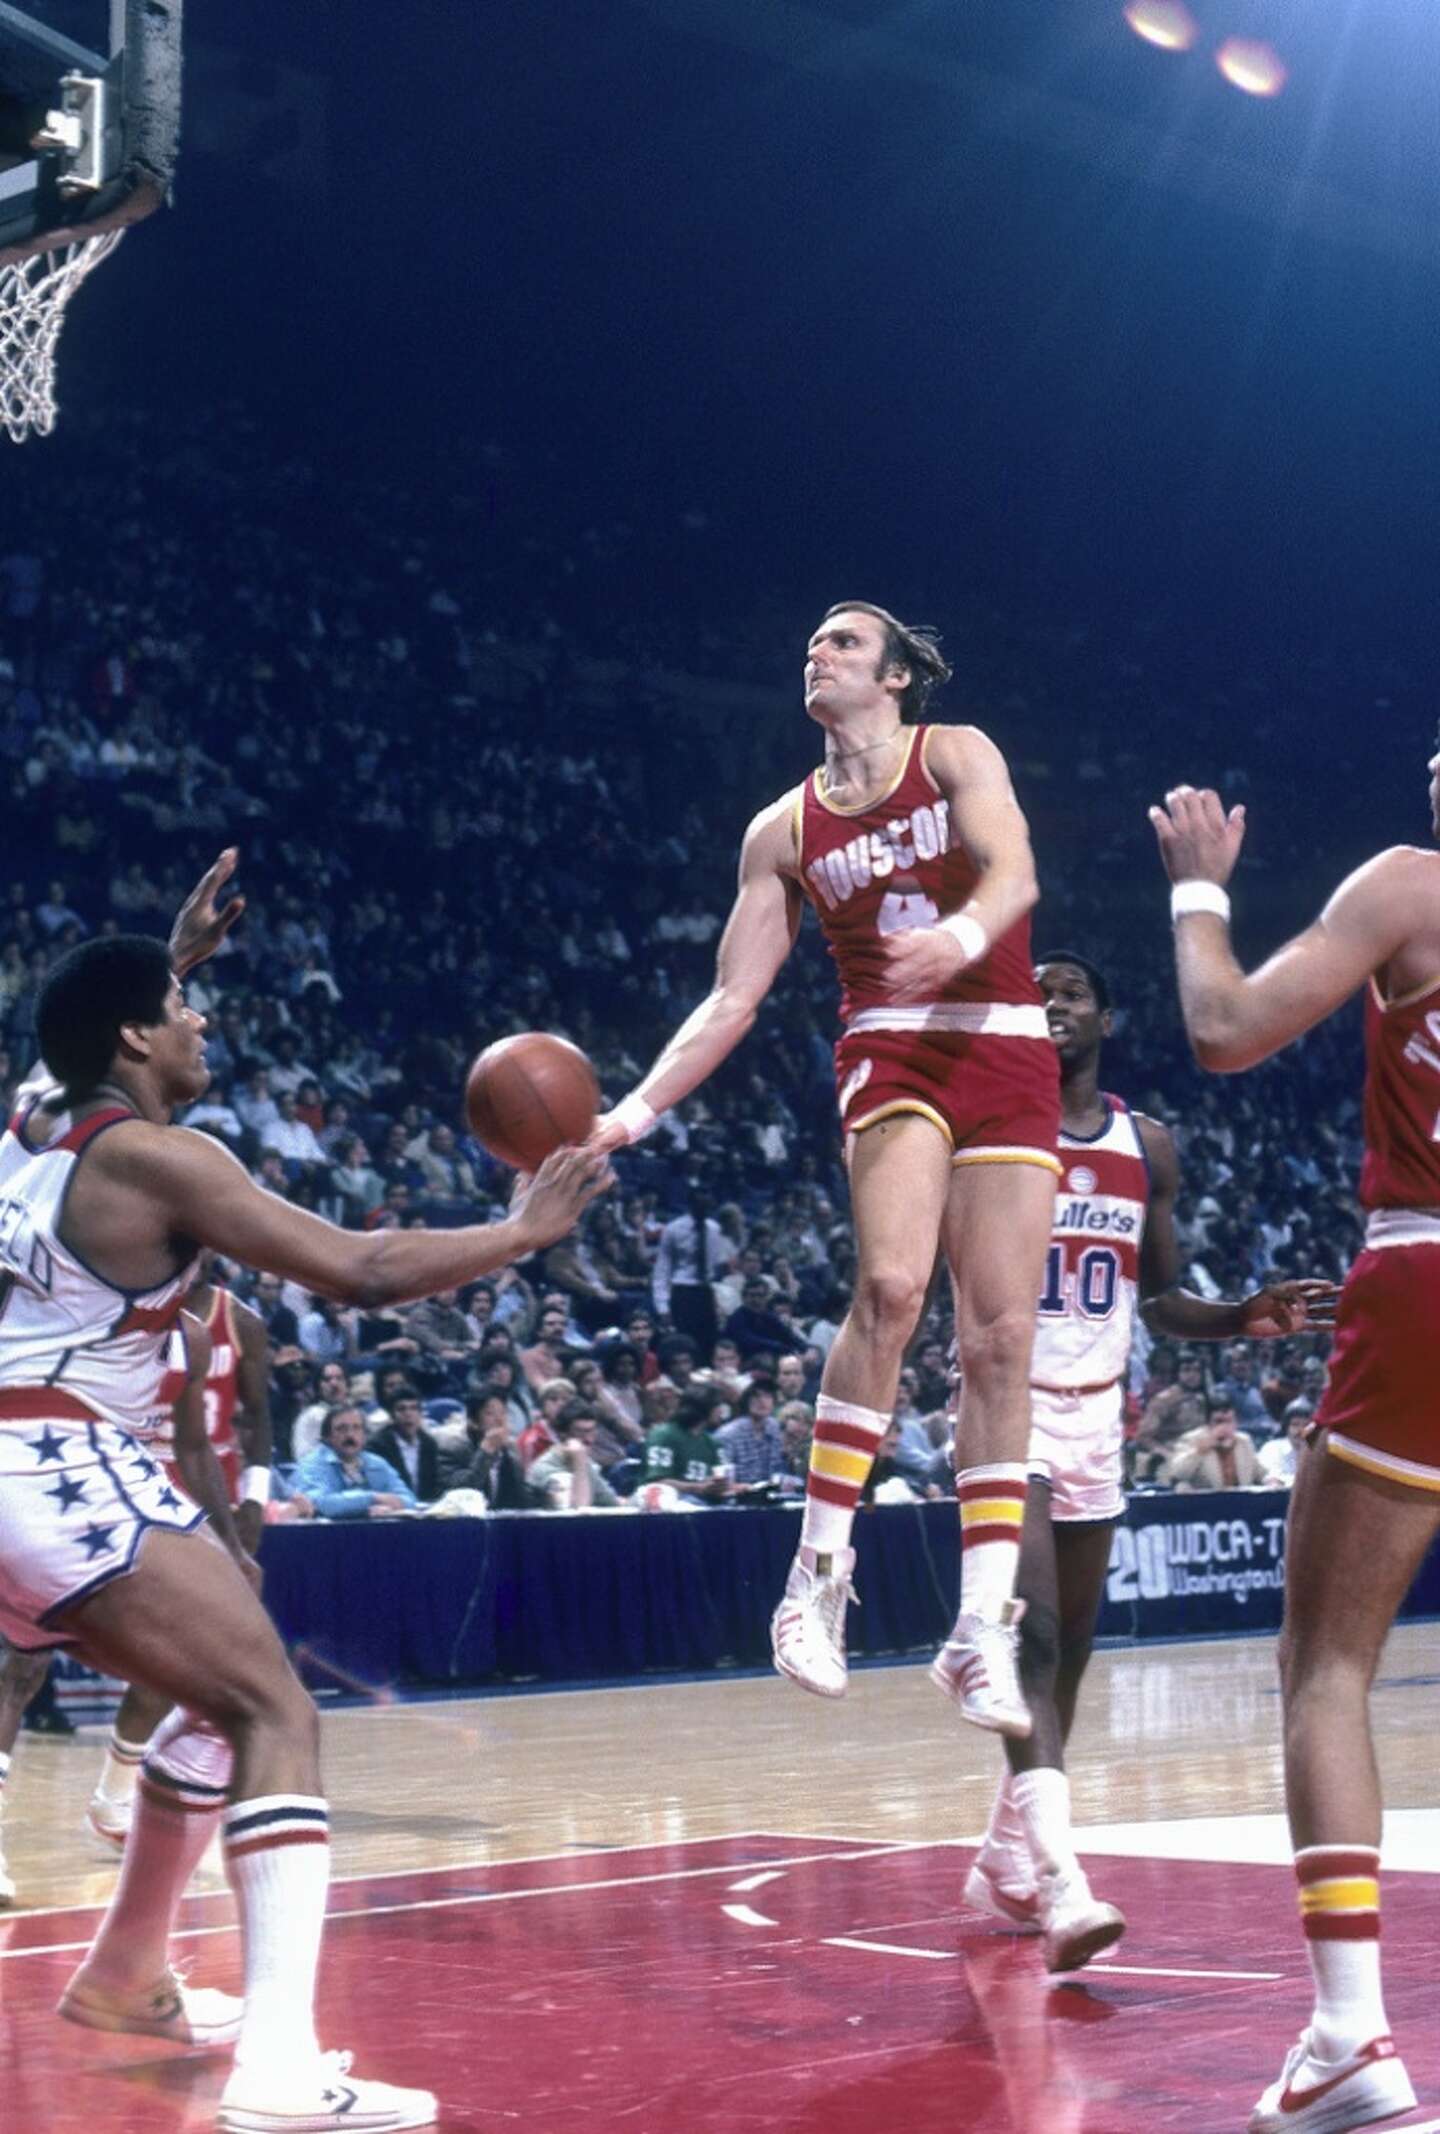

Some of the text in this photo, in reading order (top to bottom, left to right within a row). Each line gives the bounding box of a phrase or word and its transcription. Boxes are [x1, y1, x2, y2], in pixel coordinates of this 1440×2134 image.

[1037, 1244, 1121, 1320] 10
[1107, 1525, 1169, 1603] 20
[1168, 1519, 1288, 1564] WDCA-T
